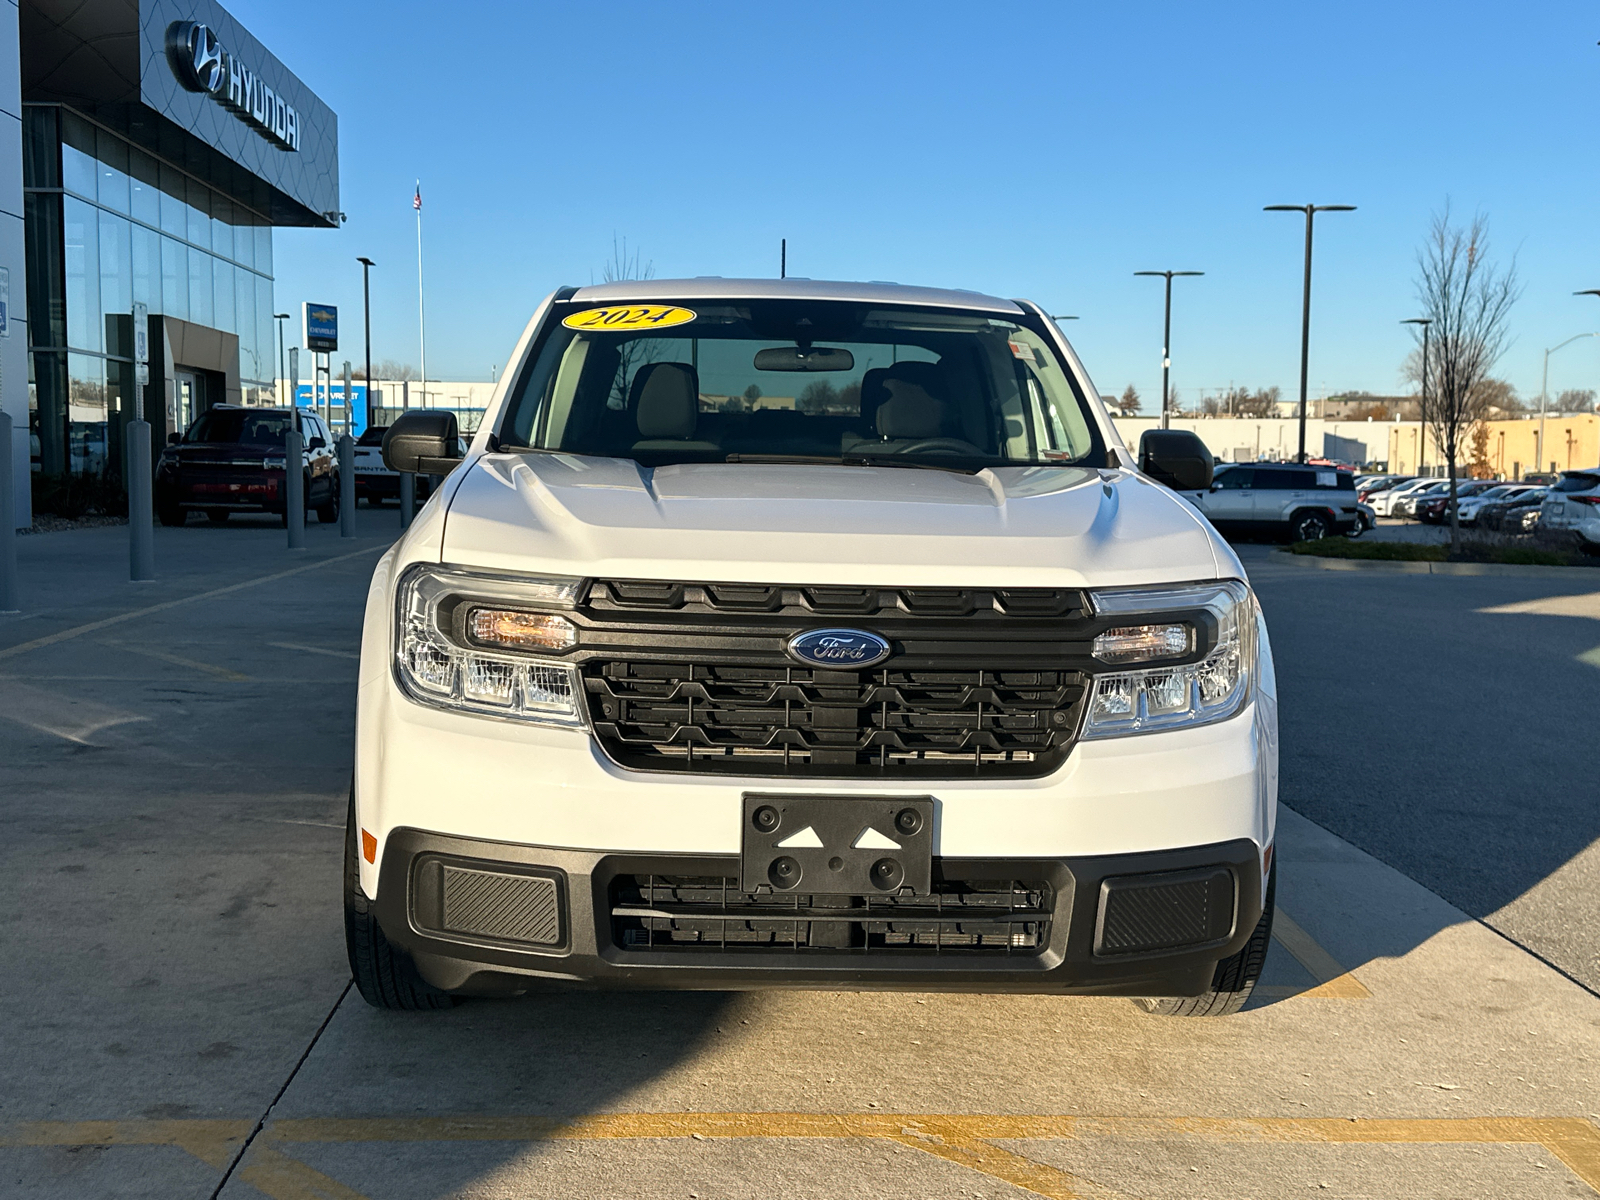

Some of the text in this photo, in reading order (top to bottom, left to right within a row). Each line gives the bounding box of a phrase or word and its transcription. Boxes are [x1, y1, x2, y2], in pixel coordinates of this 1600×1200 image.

[229, 53, 300, 152] HYUNDAI
[580, 307, 676, 326] 2024
[309, 326, 336, 336] CHEVROLET
[813, 637, 867, 659] Ford
